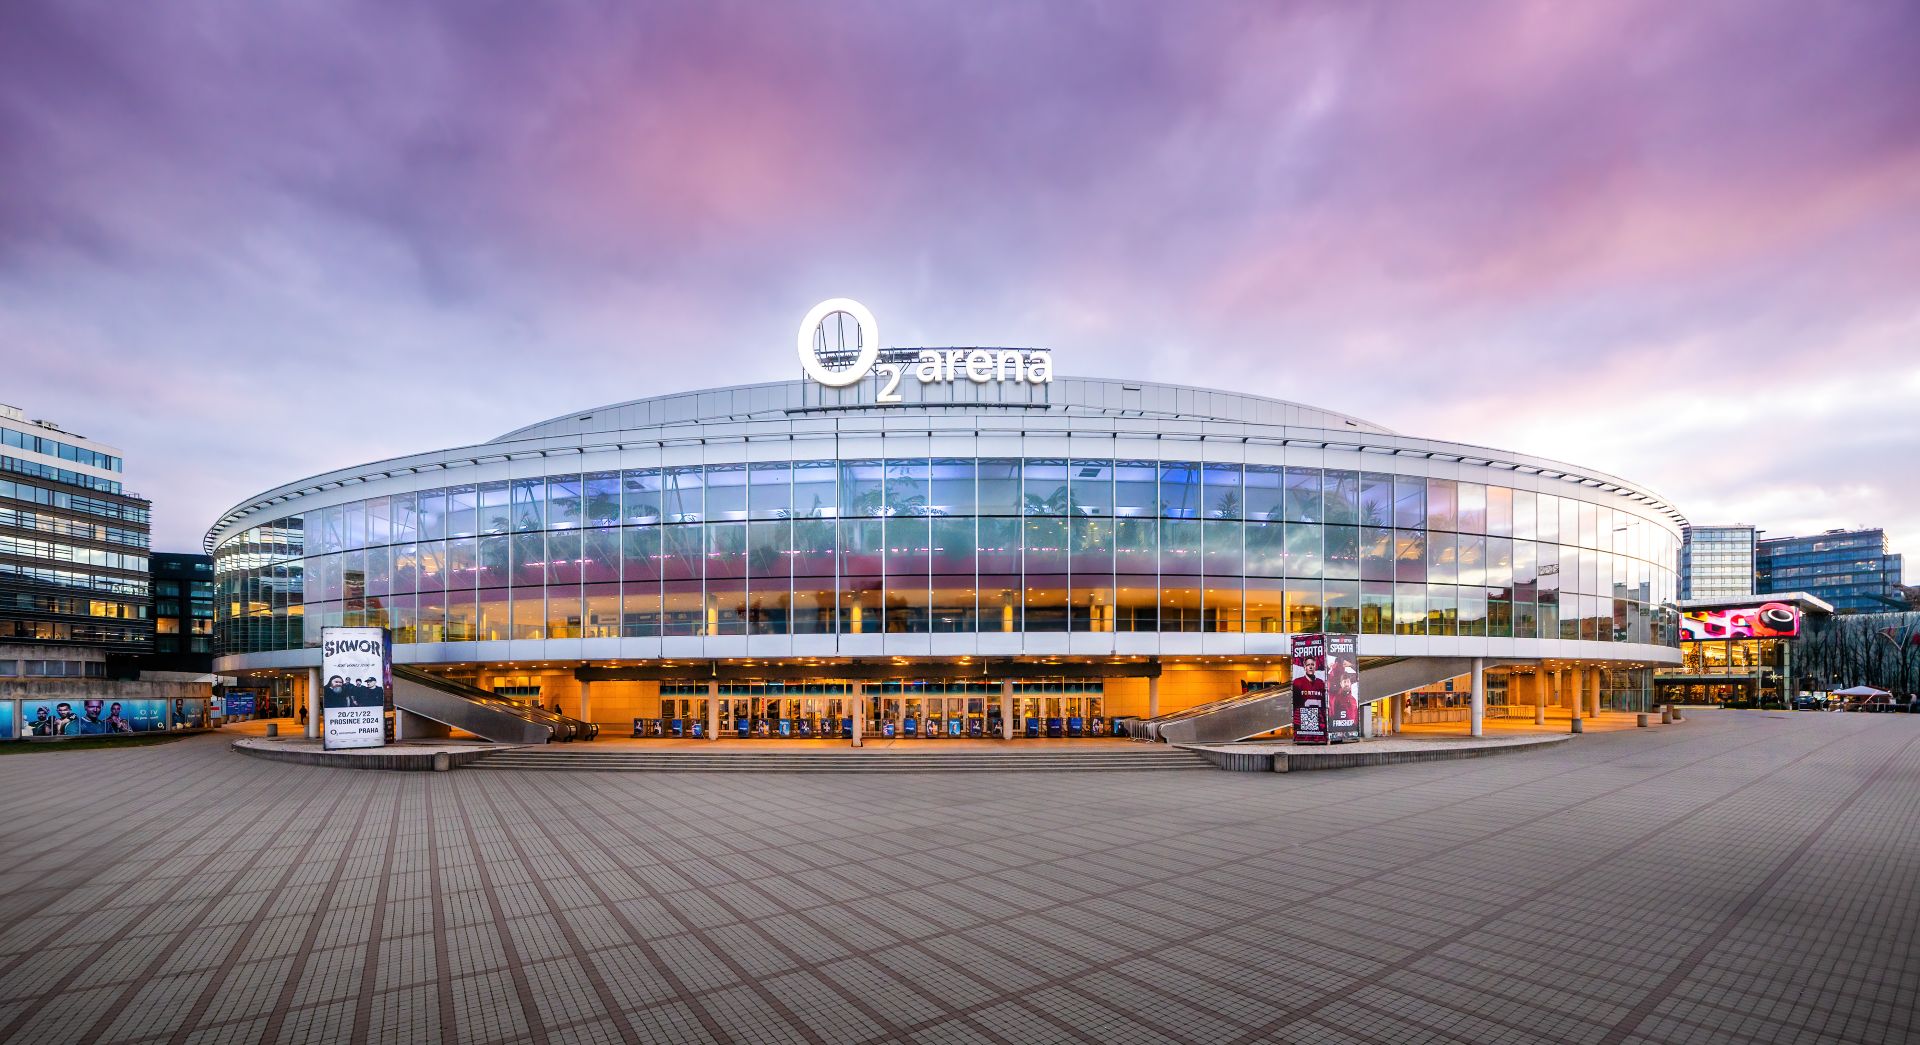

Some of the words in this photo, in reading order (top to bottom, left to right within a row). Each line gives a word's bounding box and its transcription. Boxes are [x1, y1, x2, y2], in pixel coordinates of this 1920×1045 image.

[797, 297, 902, 402] O2
[915, 350, 1053, 384] arena
[325, 640, 381, 657] SKWOR
[1294, 646, 1323, 657] SPARTA
[1330, 644, 1353, 652] SPARTA
